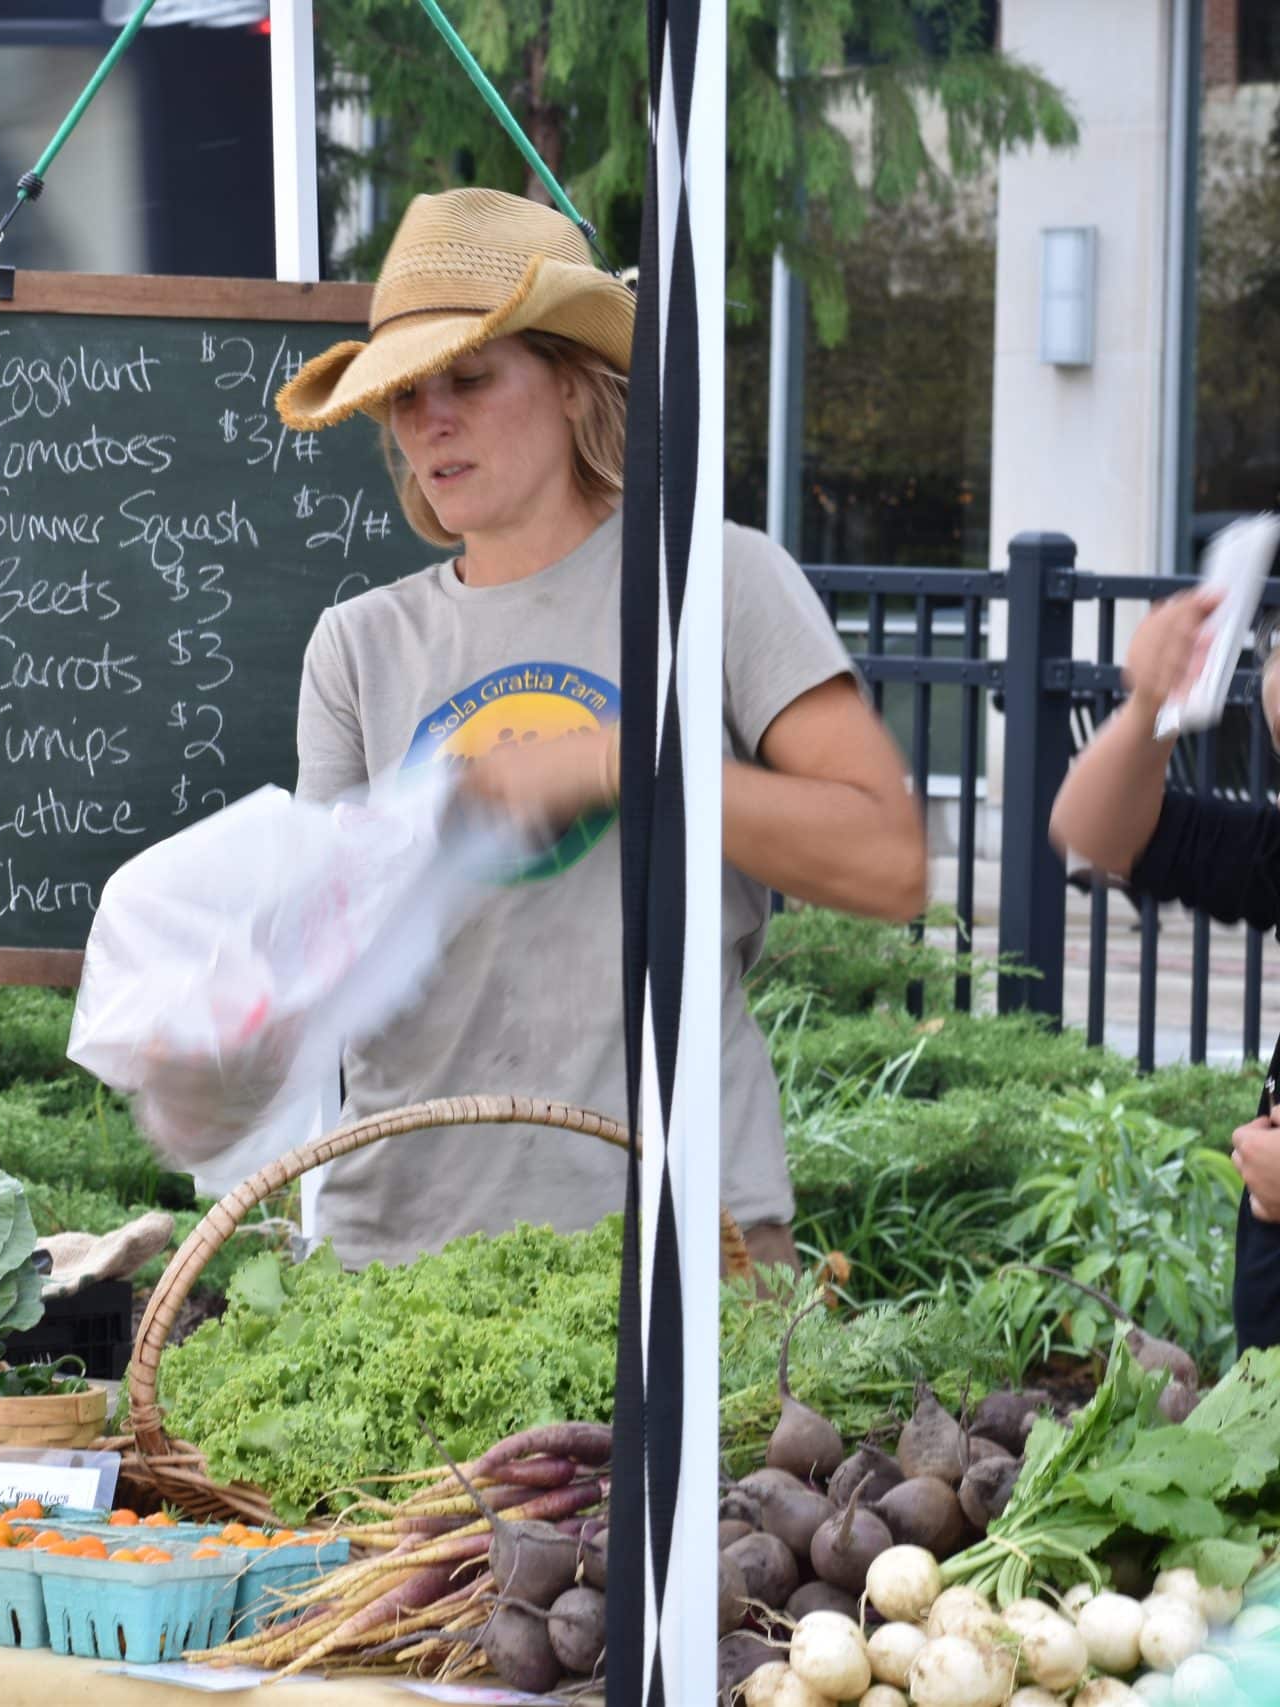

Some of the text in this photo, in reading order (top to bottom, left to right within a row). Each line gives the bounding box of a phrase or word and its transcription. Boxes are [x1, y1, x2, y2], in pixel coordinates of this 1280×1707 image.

[119, 489, 260, 570] Squash
[161, 564, 233, 624] $3
[167, 628, 235, 691] $3
[167, 701, 226, 765] $2
[427, 667, 609, 740] Sola Gratia Farm
[7, 1484, 70, 1505] Tomatoes
